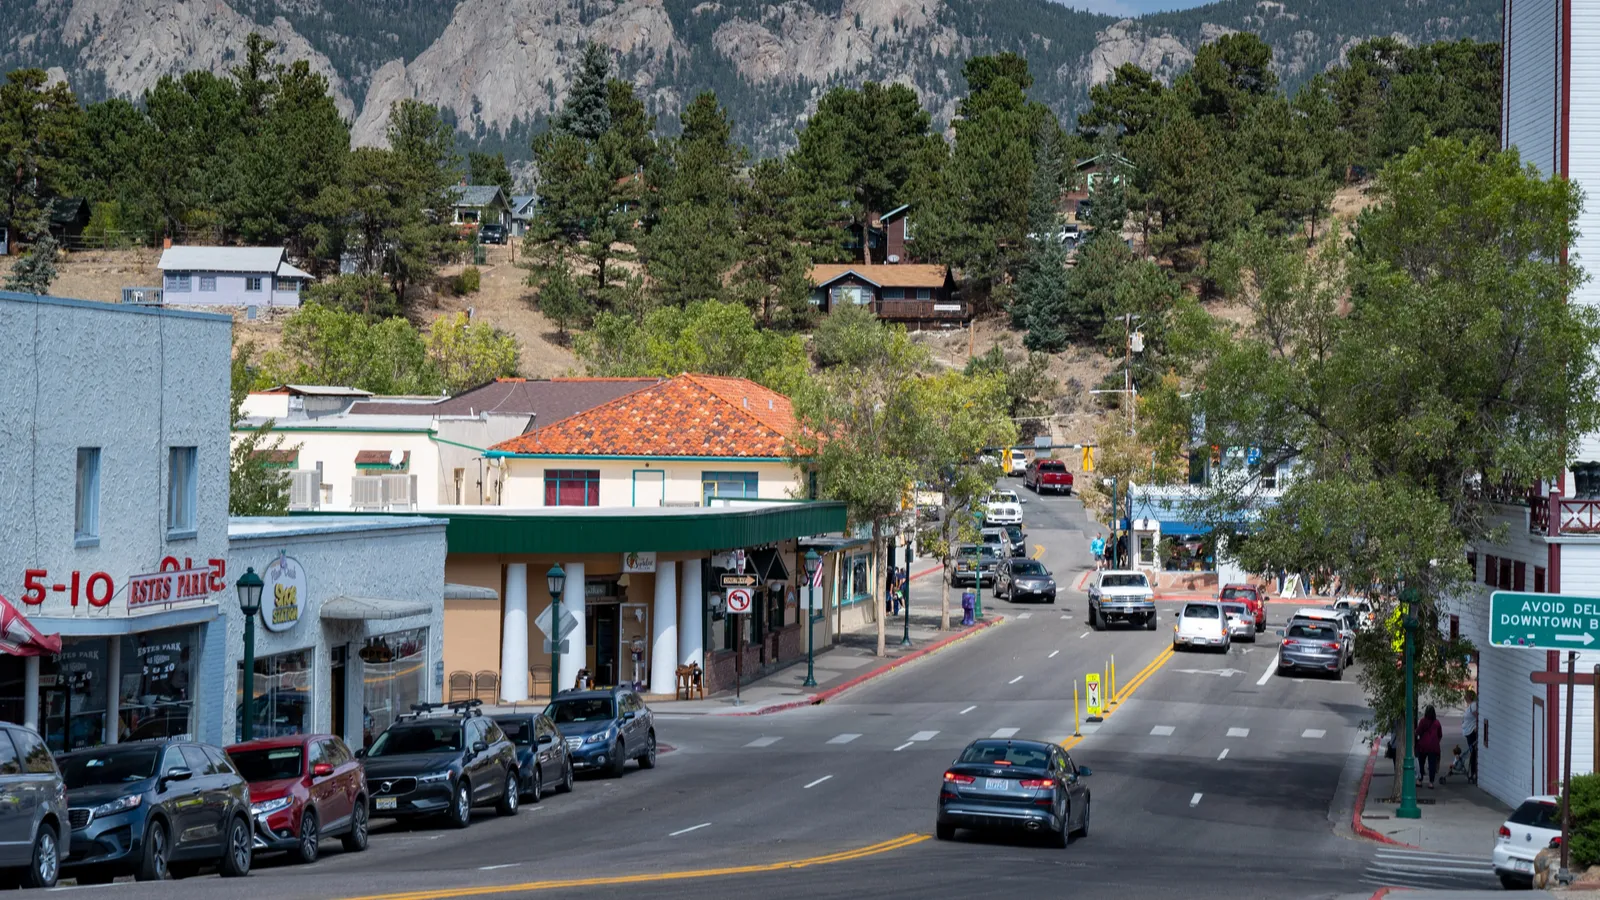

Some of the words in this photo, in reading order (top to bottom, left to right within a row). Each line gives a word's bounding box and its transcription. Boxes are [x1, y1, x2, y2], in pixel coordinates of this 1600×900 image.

[21, 569, 115, 607] 5-10
[130, 575, 172, 604] ESTES
[177, 571, 208, 598] PARK
[272, 606, 298, 624] STATION
[1521, 601, 1565, 614] AVOID
[1573, 603, 1600, 616] DEL
[1501, 614, 1582, 629] DOWNTOWN
[52, 652, 76, 663] ESTES
[79, 650, 99, 660] PARK
[137, 645, 160, 657] ESTES
[162, 642, 181, 652] PARK
[143, 665, 149, 675] 5
[164, 663, 175, 672] 10
[58, 674, 65, 684] 5
[81, 671, 92, 681] 10
